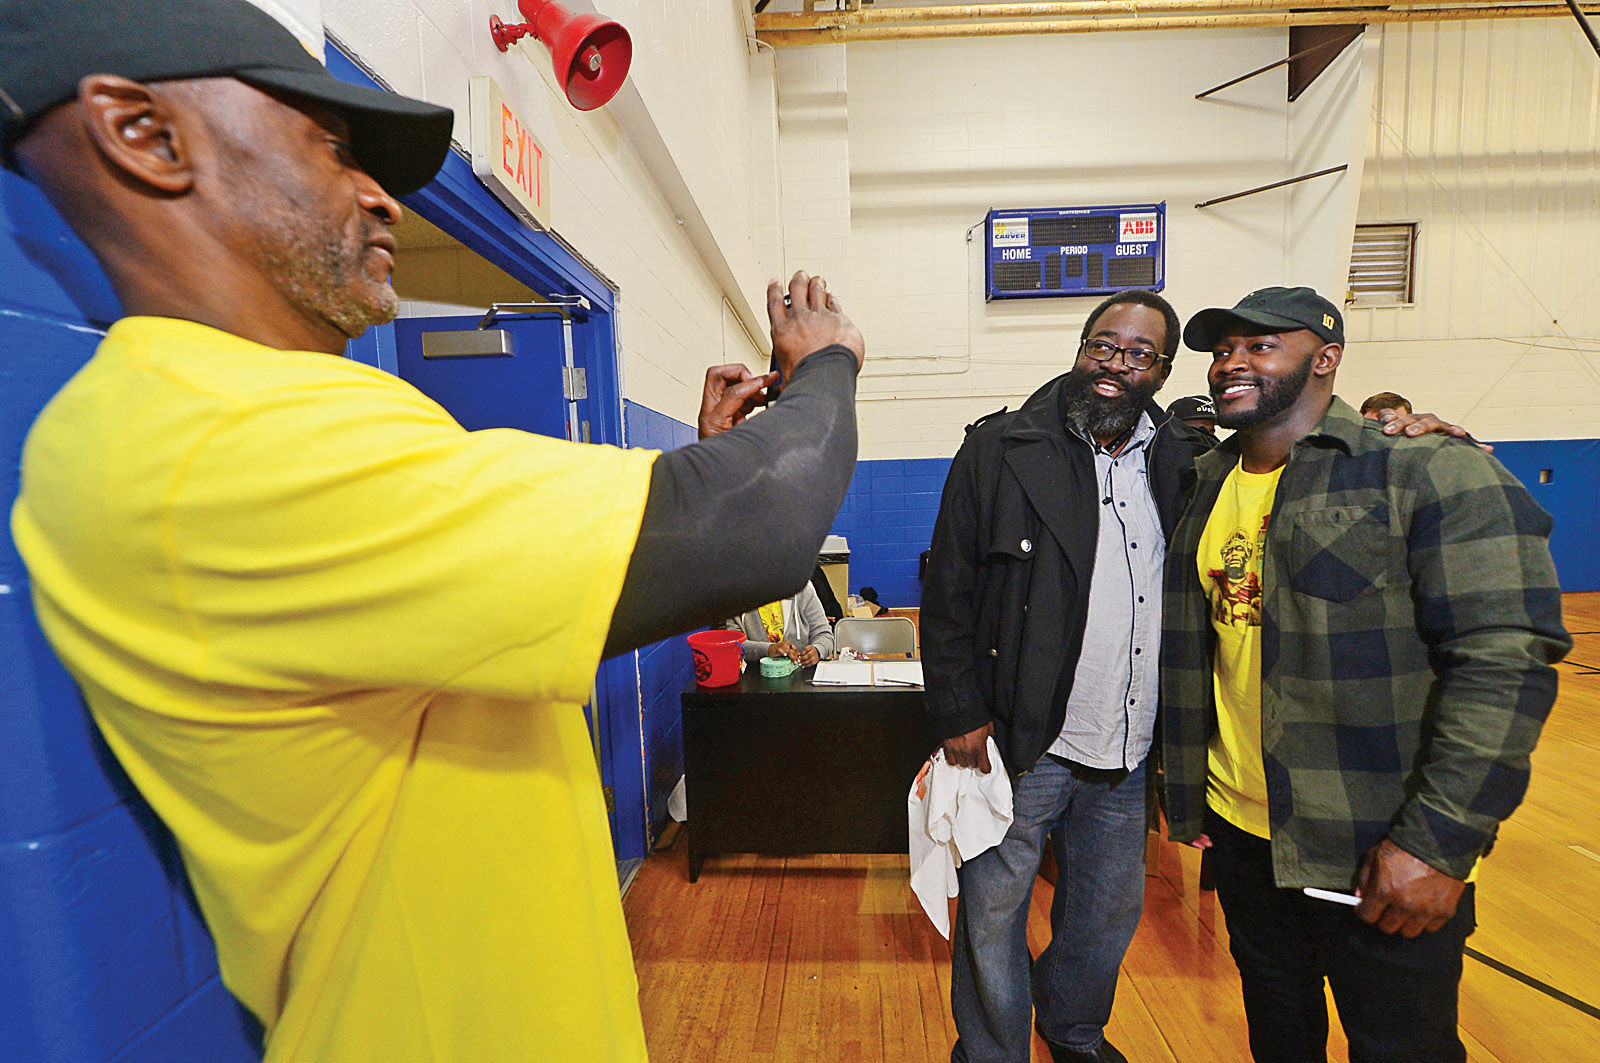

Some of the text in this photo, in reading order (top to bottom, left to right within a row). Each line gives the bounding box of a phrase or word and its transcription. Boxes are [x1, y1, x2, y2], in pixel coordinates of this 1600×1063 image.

[501, 102, 542, 207] EXIT
[1123, 221, 1154, 235] ABB
[1002, 248, 1032, 260] HOME
[1060, 246, 1088, 256] PERIOD
[1116, 244, 1148, 256] GUEST
[1322, 313, 1335, 330] 10
